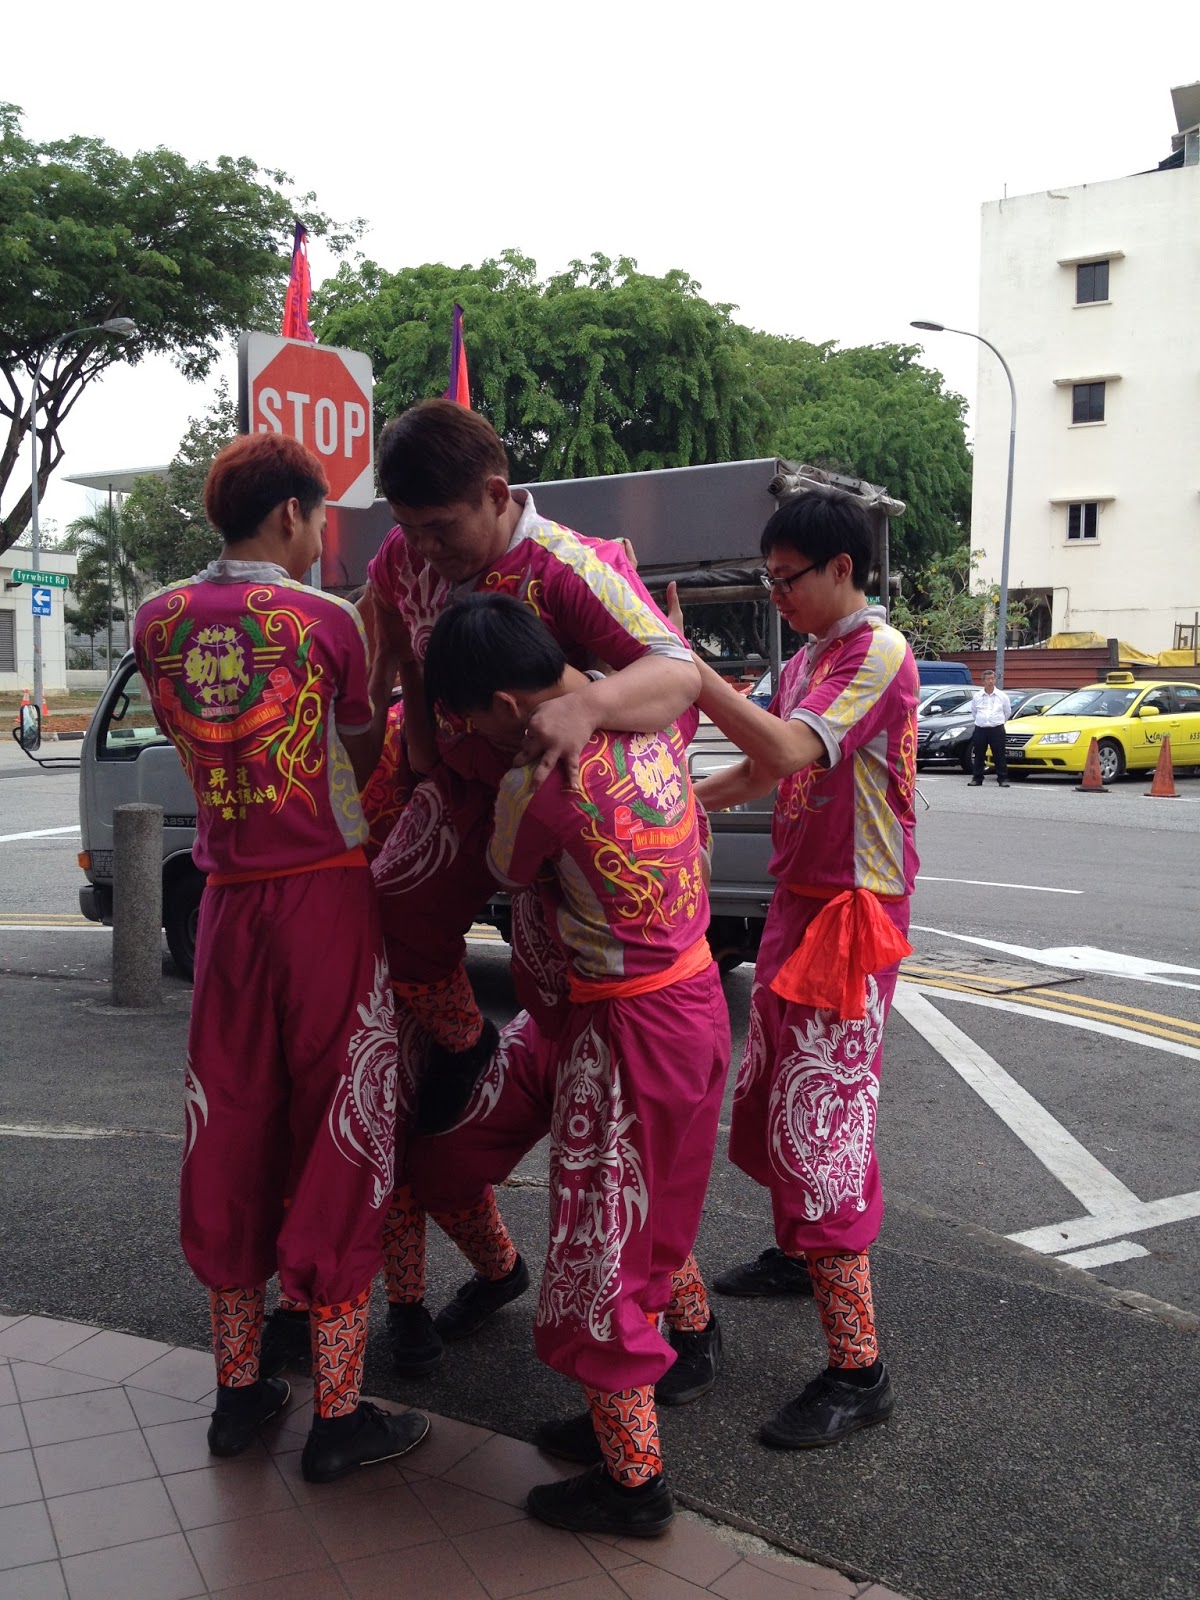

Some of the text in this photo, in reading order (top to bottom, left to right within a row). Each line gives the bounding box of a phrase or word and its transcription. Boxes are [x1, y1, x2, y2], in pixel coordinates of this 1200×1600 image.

[257, 387, 366, 459] STOP
[17, 570, 65, 584] Tyrwhitt Rd
